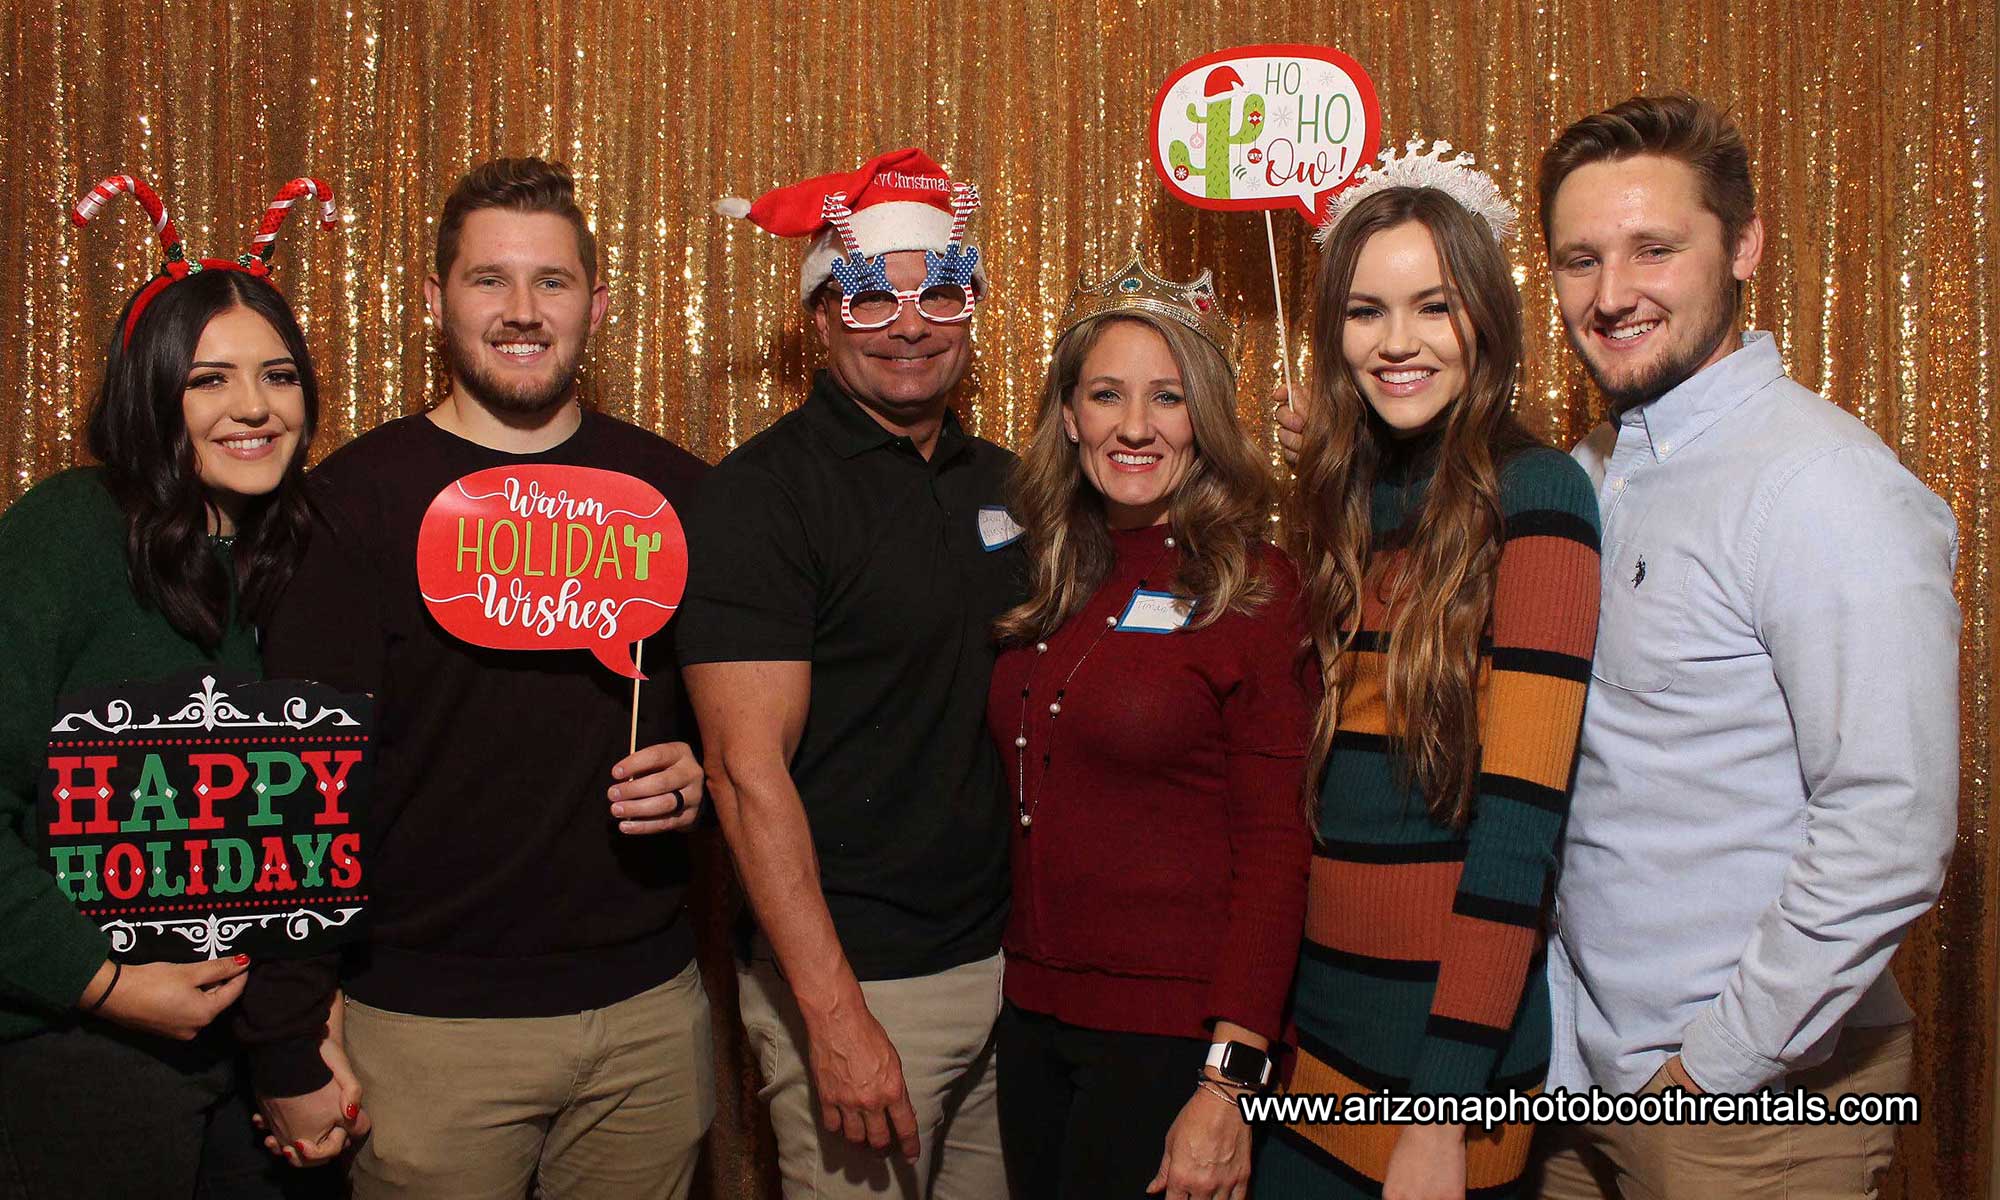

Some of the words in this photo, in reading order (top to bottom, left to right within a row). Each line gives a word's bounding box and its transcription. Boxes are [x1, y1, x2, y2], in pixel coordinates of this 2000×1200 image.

[1265, 62, 1301, 95] HO
[1297, 93, 1351, 144] HO
[1265, 138, 1347, 187] Ow!
[504, 477, 606, 525] Warm
[477, 573, 623, 639] Wishes
[48, 750, 362, 835] HAPPY
[50, 833, 362, 901] HOLIDAYS
